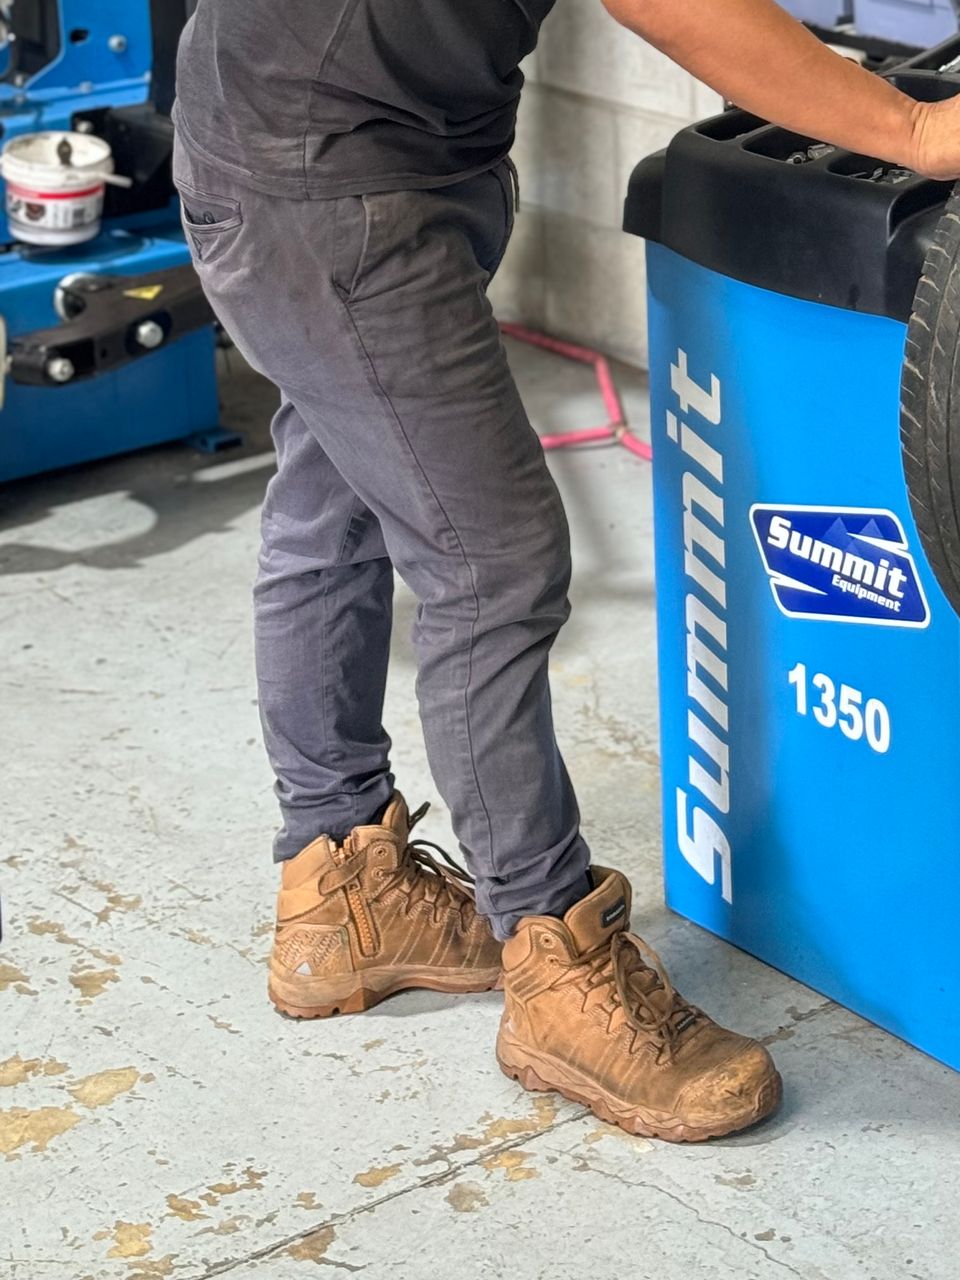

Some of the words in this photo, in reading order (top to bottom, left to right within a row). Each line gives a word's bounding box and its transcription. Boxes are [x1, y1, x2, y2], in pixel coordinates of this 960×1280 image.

[767, 515, 908, 599] Summit
[831, 574, 902, 613] Equipment
[666, 348, 733, 905] Summit
[788, 662, 891, 754] 1350
